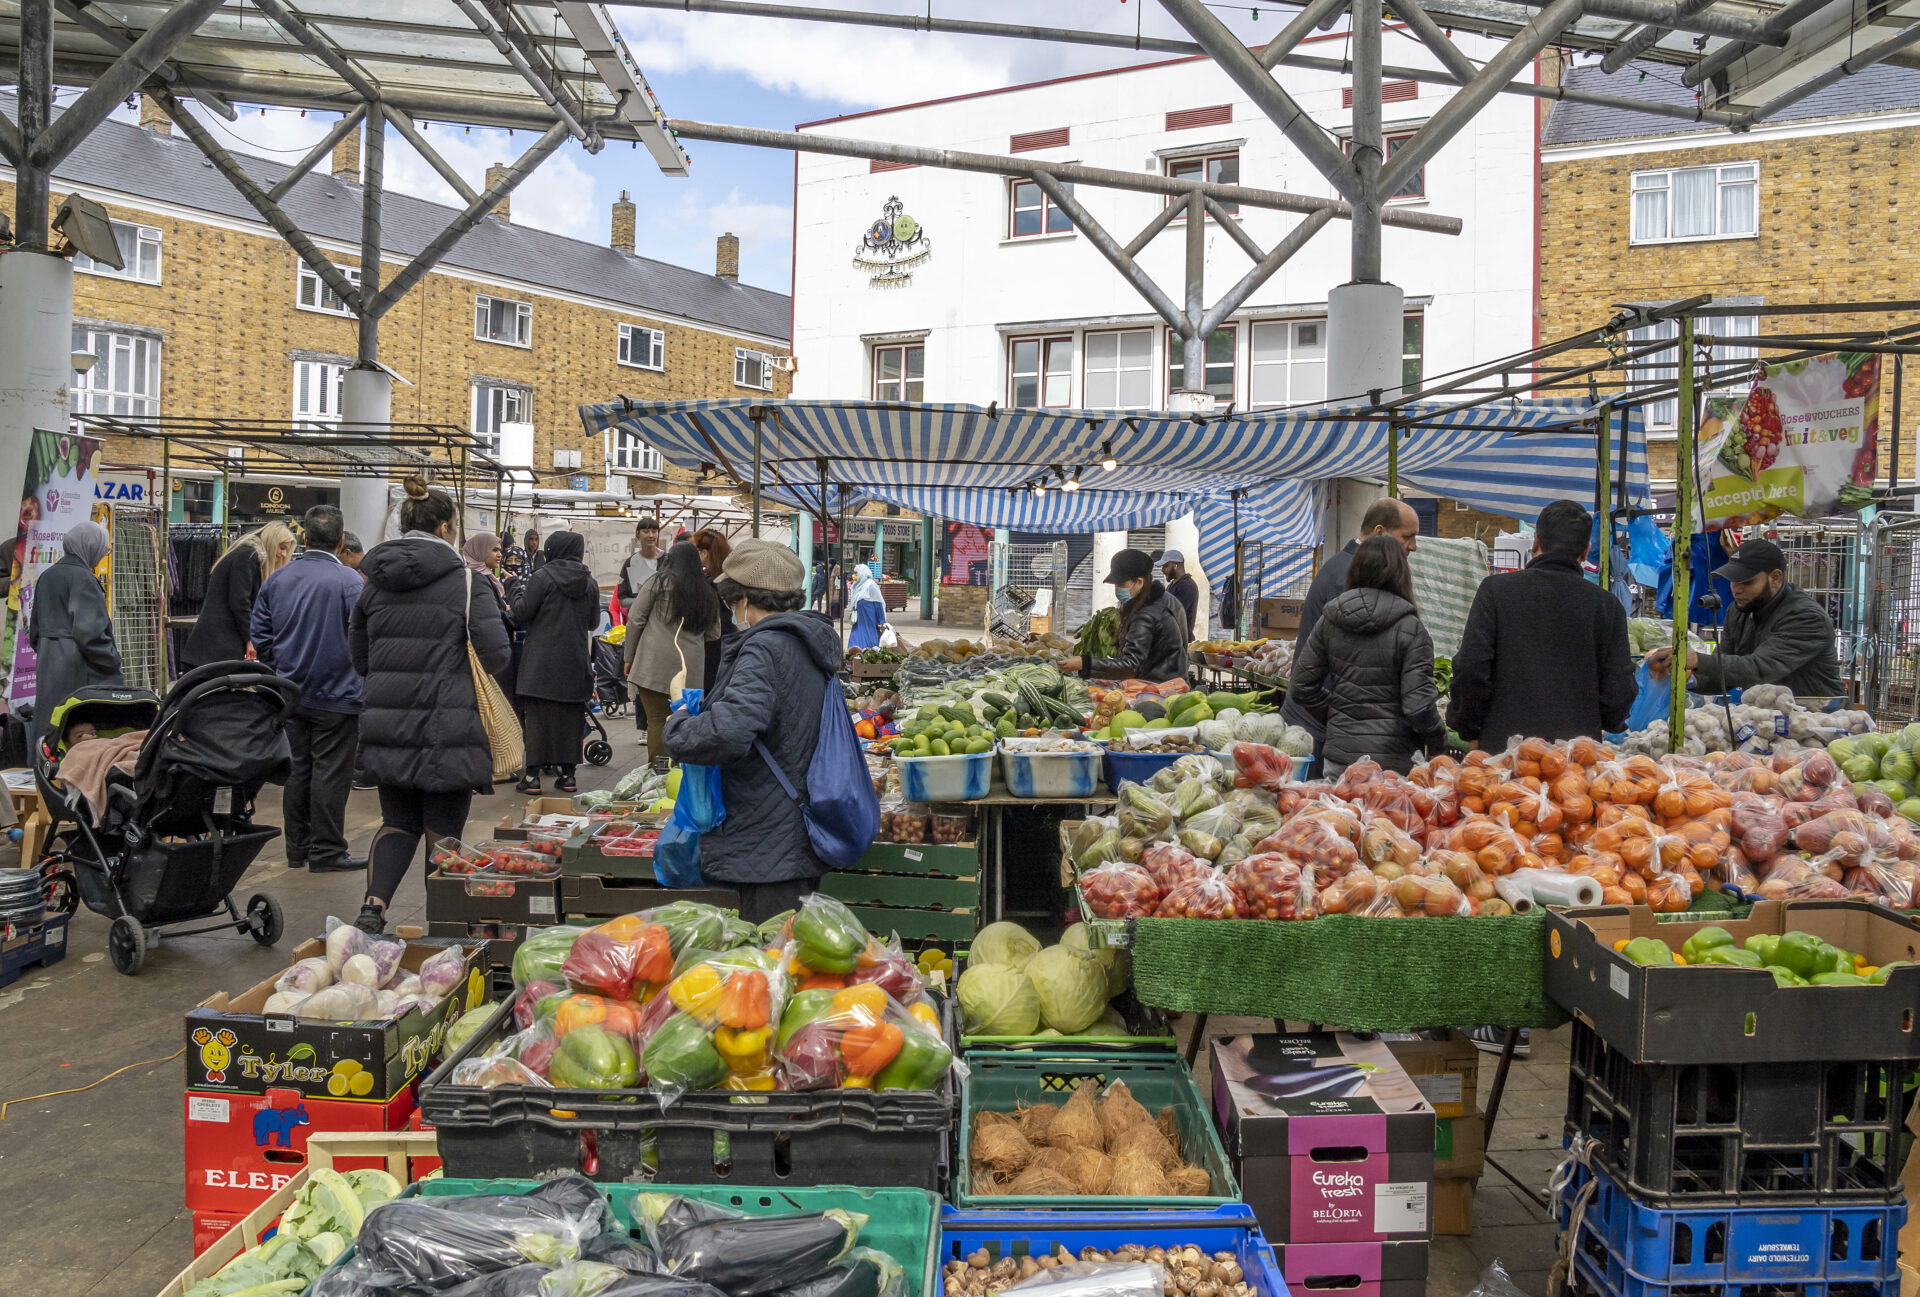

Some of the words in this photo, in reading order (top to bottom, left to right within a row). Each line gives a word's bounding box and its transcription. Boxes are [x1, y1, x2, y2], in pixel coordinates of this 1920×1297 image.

[853, 256, 889, 273] CHRISP
[894, 246, 932, 272] STREET
[869, 271, 913, 290] MARKET
[1780, 413, 1804, 425] Rose
[1812, 407, 1860, 421] VOUCHERS
[1769, 483, 1797, 499] here
[897, 525, 910, 536] STORE
[237, 1055, 328, 1082] Tyler
[1312, 1170, 1364, 1186] Eureka
[1748, 1255, 1767, 1263] DAIRY
